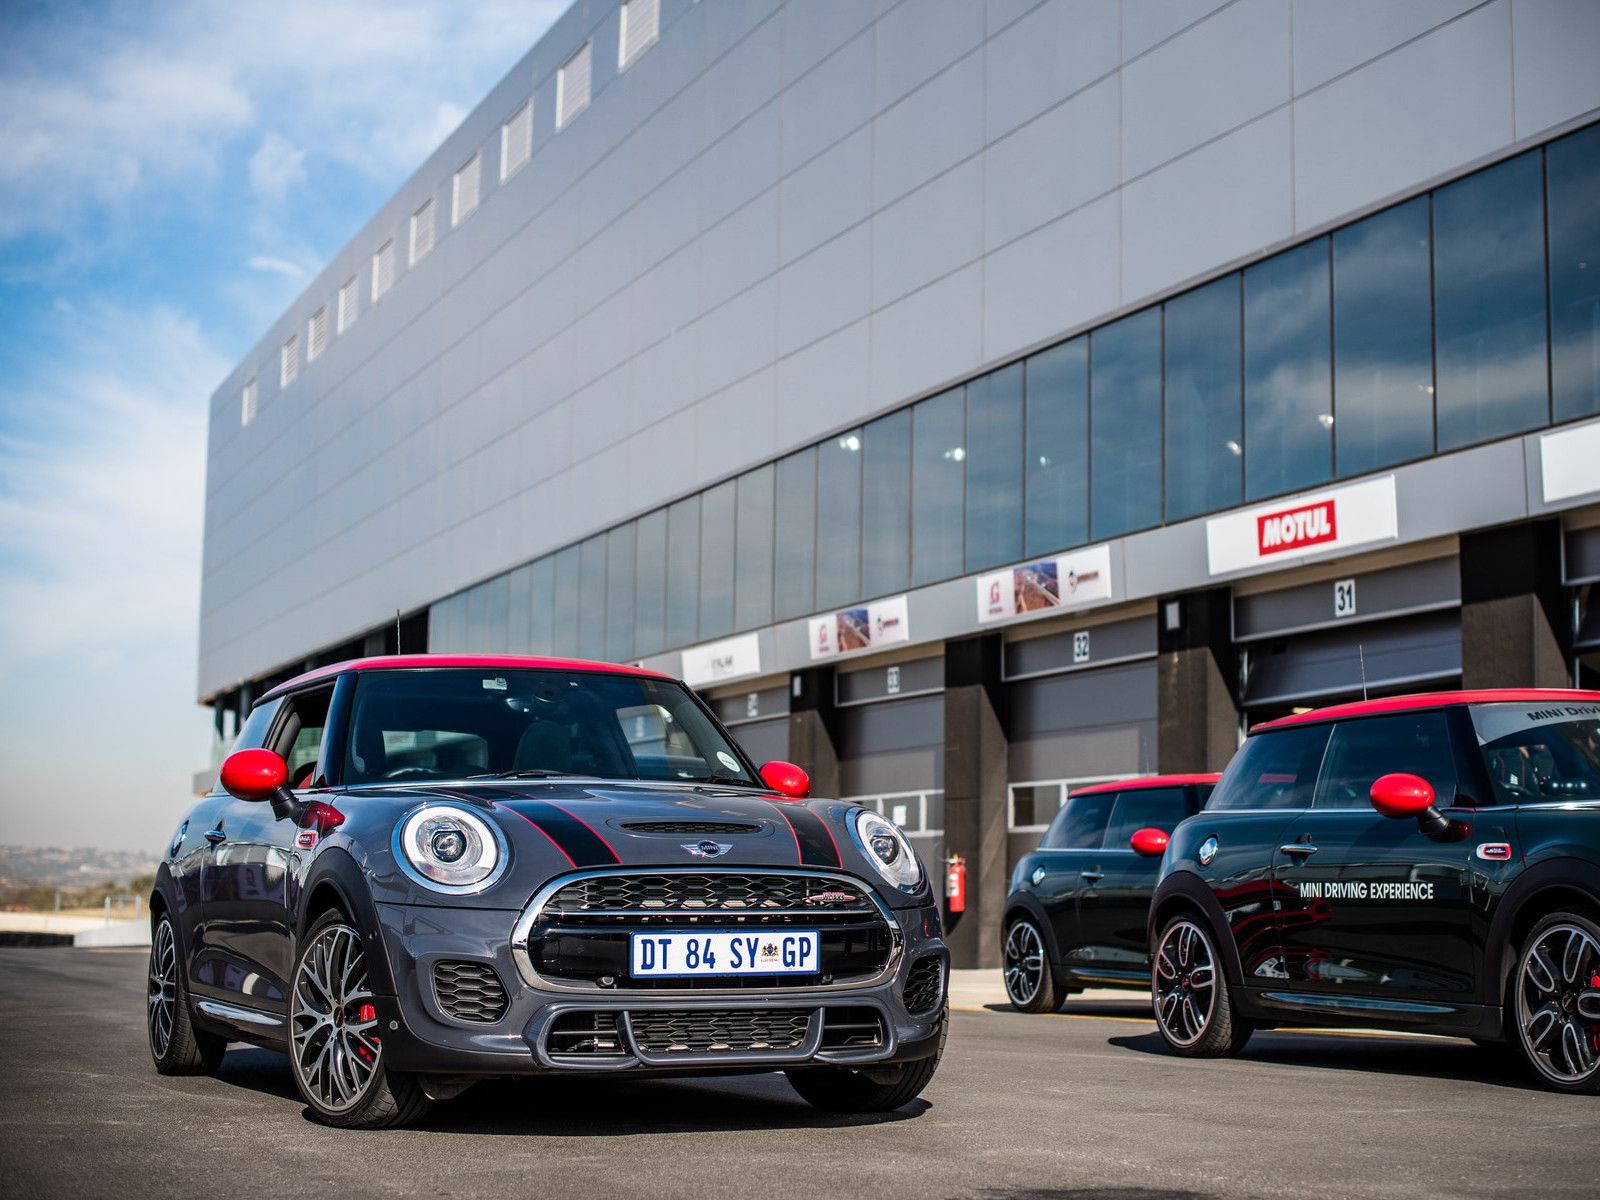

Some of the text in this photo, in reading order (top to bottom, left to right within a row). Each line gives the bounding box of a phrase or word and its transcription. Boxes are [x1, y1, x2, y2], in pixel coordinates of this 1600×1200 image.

[1262, 506, 1331, 548] MOTUL
[1337, 585, 1353, 612] 31
[1076, 635, 1088, 657] 32
[1527, 708, 1564, 720] MINI
[1300, 883, 1434, 899] MINI DRIVING EXPERIENCE
[641, 936, 811, 970] DT 84 SY GP
